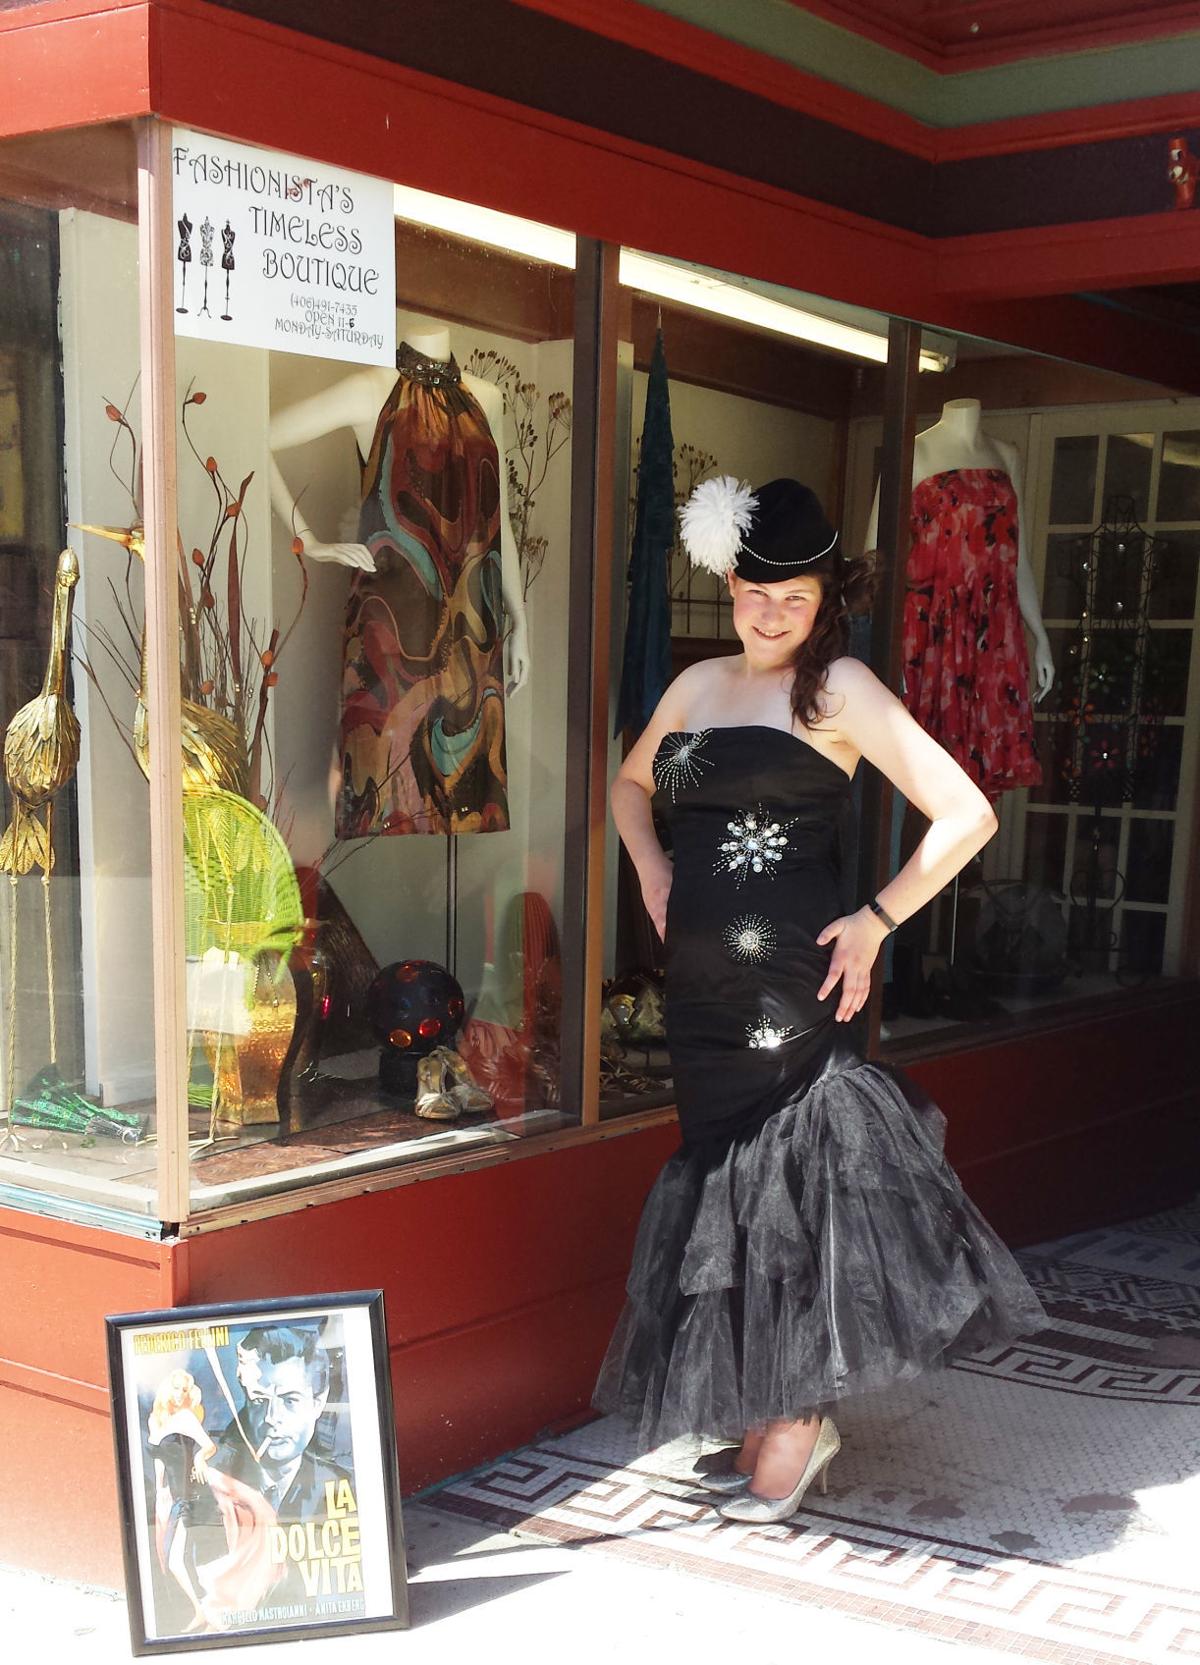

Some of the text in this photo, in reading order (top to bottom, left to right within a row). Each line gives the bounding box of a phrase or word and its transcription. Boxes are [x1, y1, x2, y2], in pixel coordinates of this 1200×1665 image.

[173, 147, 354, 214] FASHIONISTA'S
[249, 206, 363, 255] TIMELESS
[263, 248, 379, 295] BOUTIQUE
[305, 310, 335, 326] OPEN
[325, 1479, 356, 1519] LA
[268, 1520, 360, 1564] DOLCE
[298, 1556, 364, 1597] VITA
